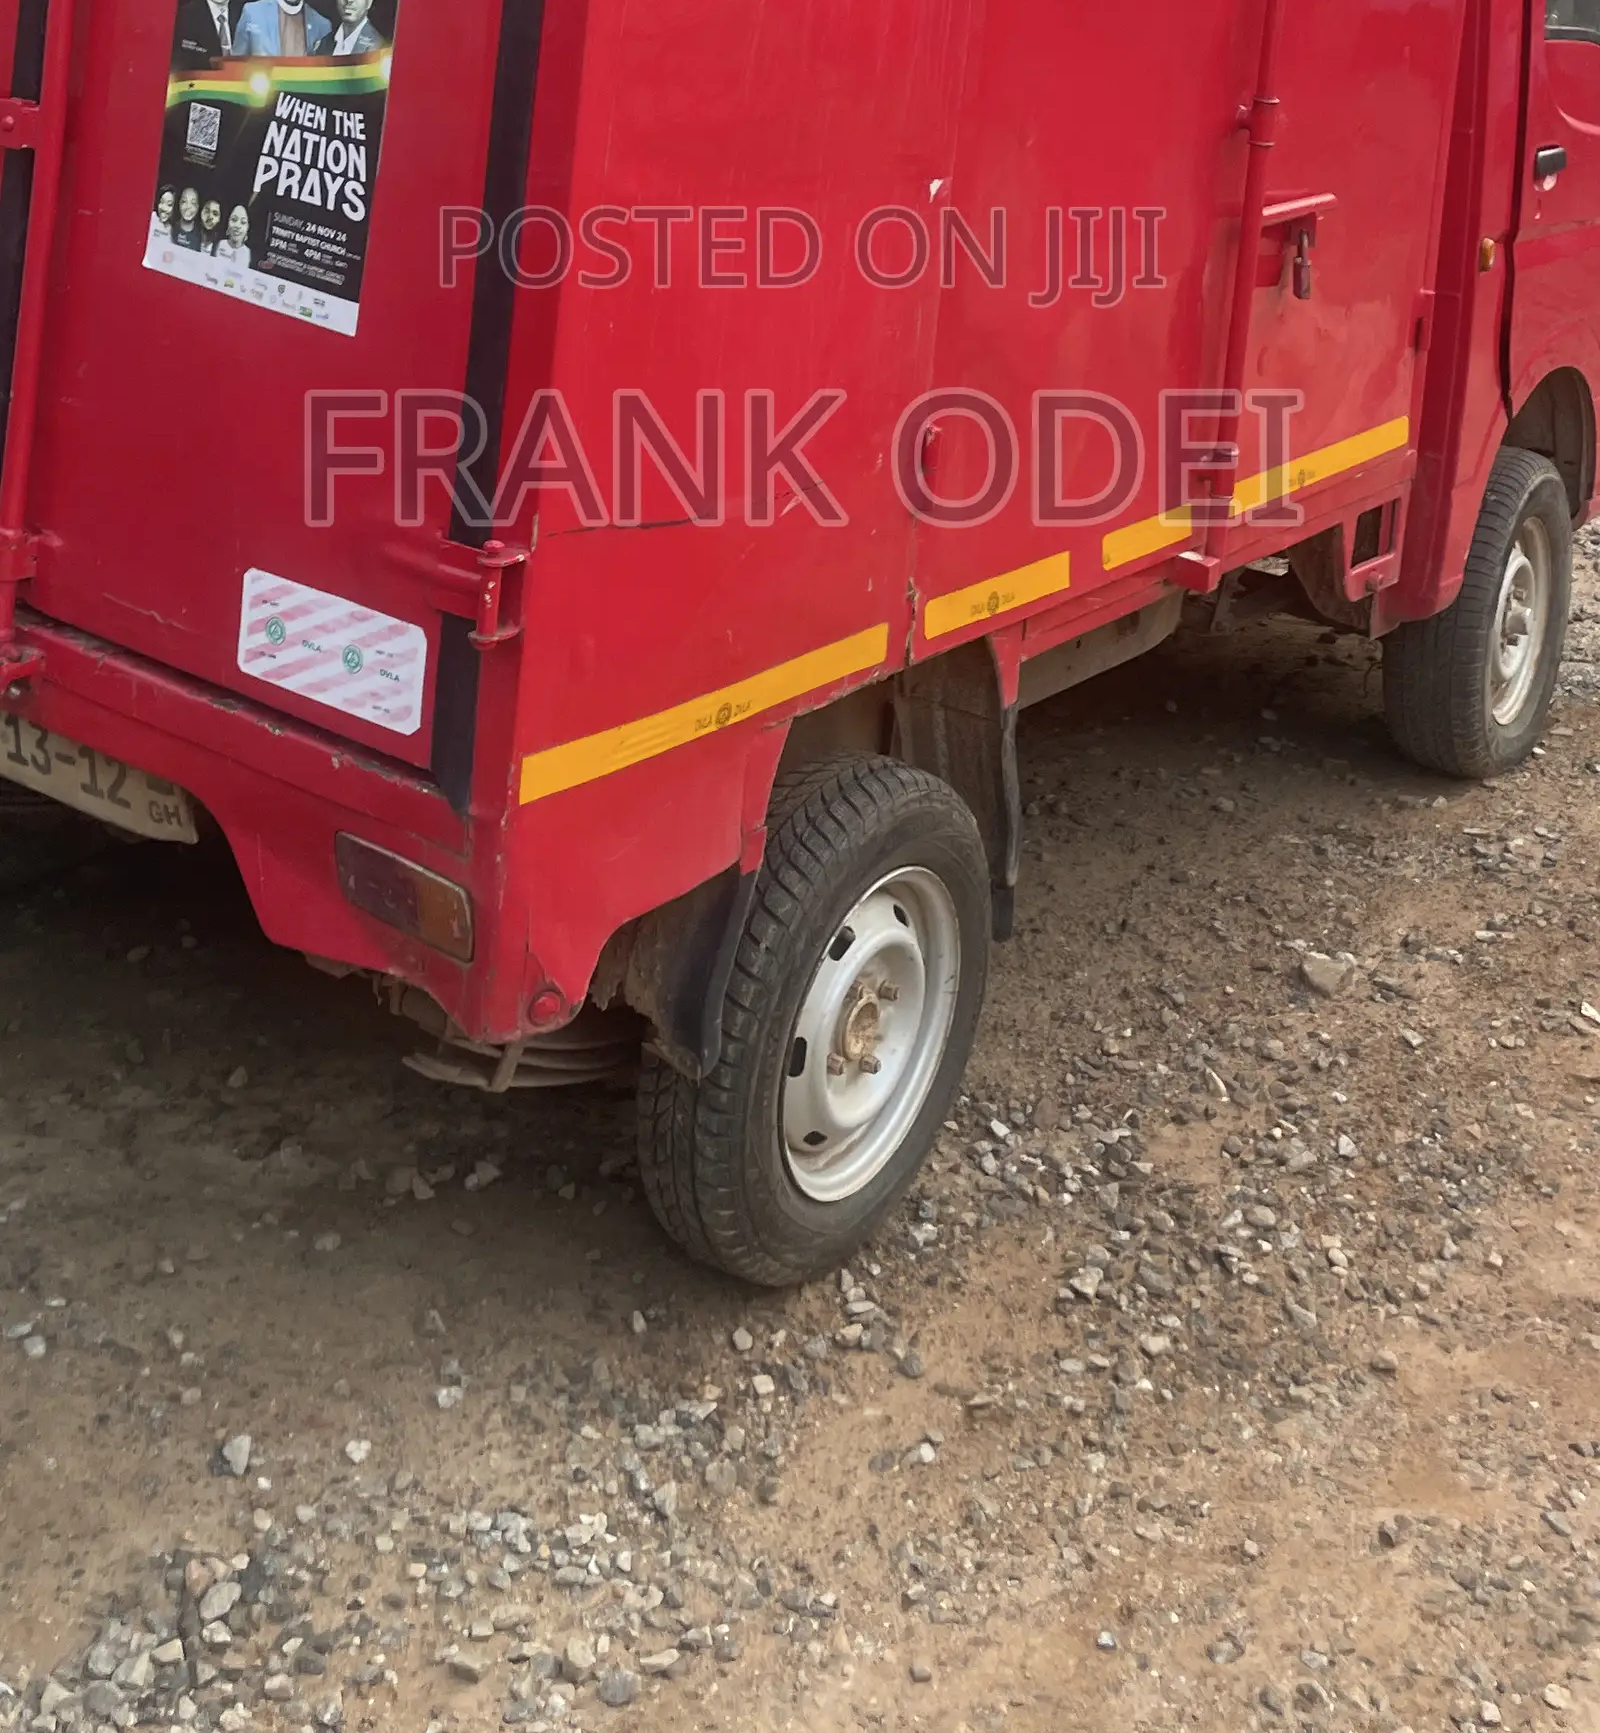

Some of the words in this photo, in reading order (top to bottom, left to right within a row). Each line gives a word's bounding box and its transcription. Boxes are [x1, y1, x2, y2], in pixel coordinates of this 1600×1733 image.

[275, 91, 327, 132] WHEN
[332, 110, 366, 140] THE
[261, 120, 366, 182] NATION
[253, 154, 366, 221] PRAYS
[305, 221, 317, 234] 24
[317, 225, 336, 239] NOV
[302, 639, 322, 653] DVLA
[380, 668, 400, 683] DVLA
[148, 800, 183, 828] GH
